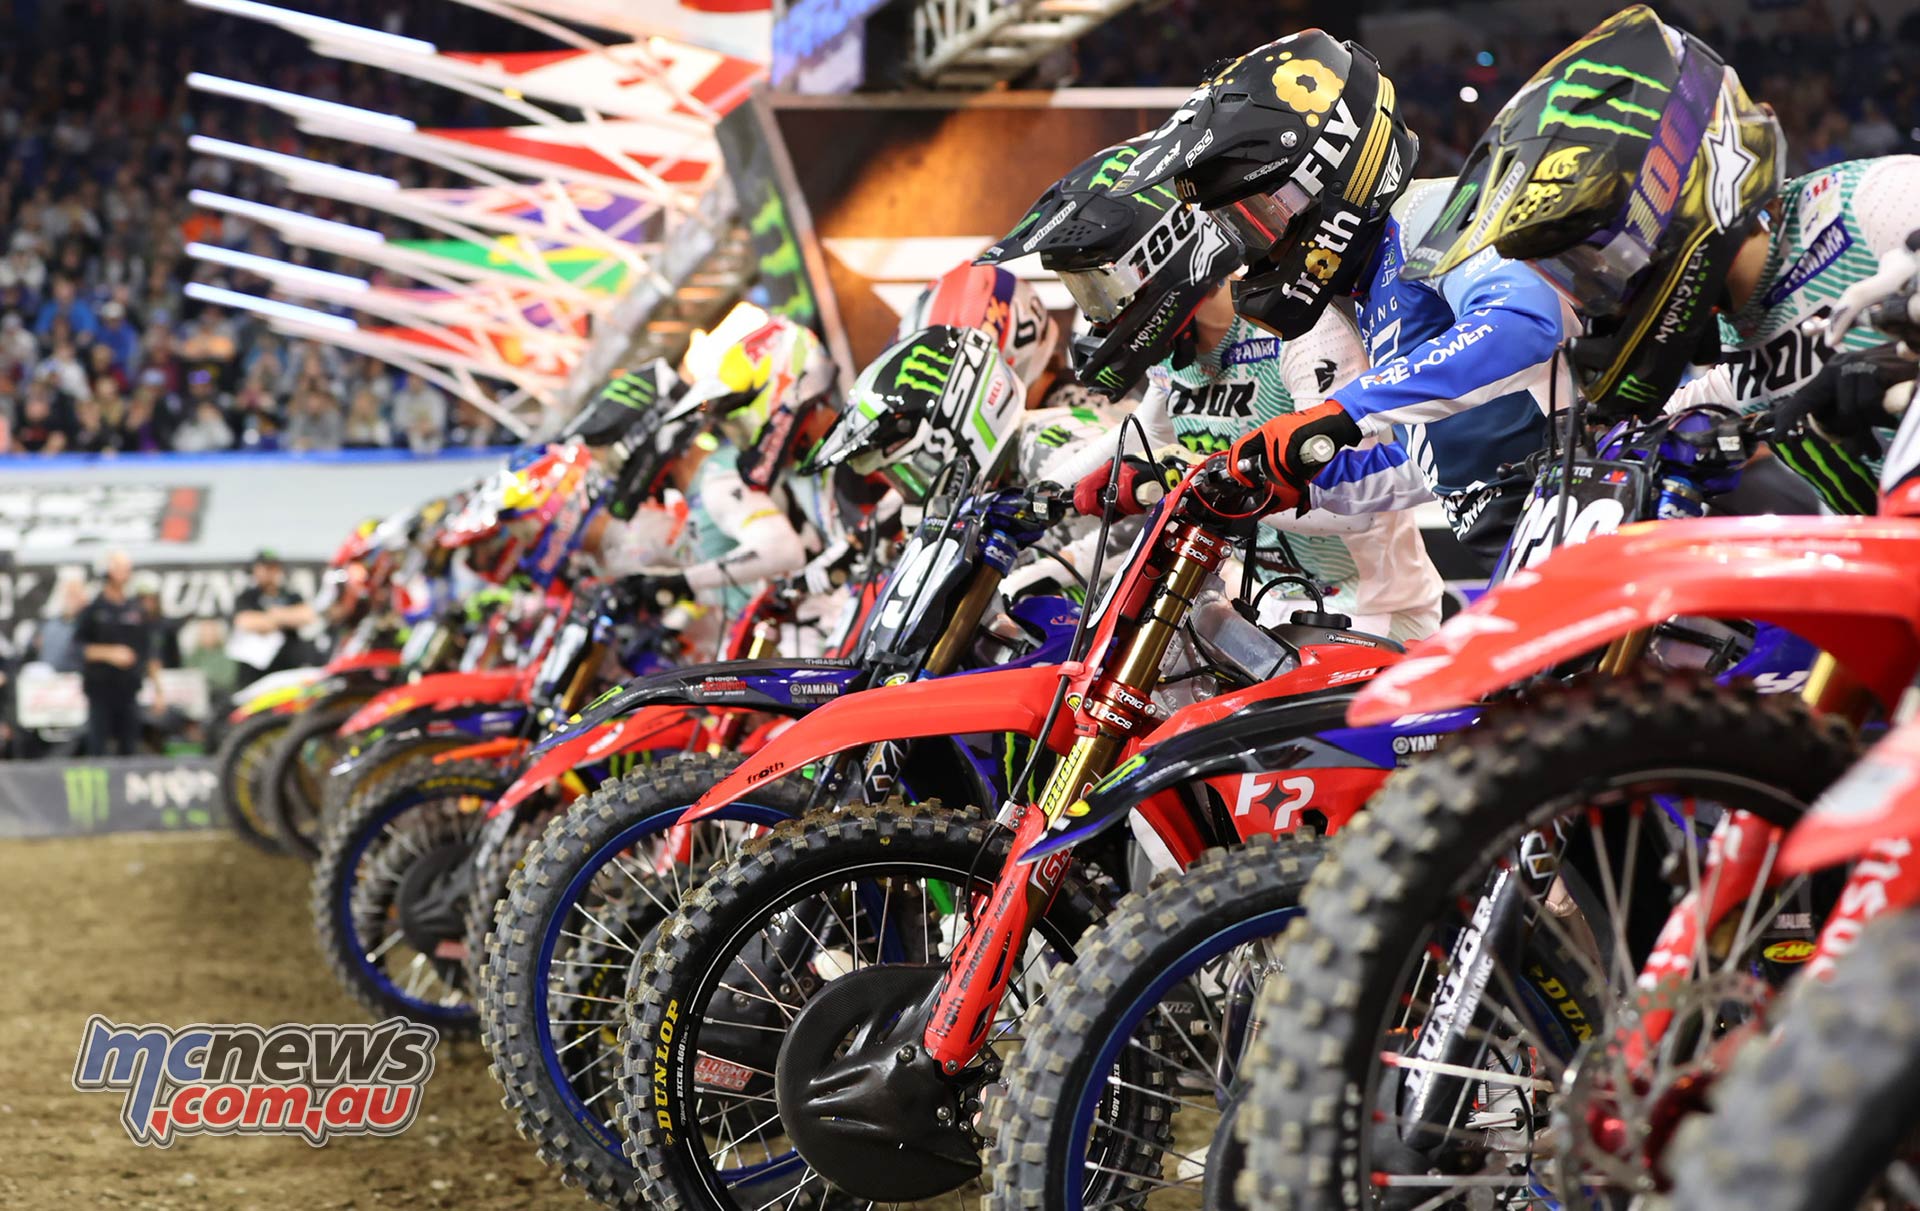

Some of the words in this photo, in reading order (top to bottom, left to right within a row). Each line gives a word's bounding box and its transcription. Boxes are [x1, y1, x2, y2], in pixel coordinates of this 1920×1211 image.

[1185, 128, 1214, 168] pod
[1290, 97, 1361, 196] FLY
[1023, 201, 1077, 253] apdesigns
[1655, 242, 1709, 343] MONSTER
[1130, 290, 1181, 352] MONSTER
[1414, 324, 1494, 374] POWER
[801, 684, 839, 695] YAMAHA
[1327, 668, 1377, 685] 250
[1408, 735, 1440, 752] YAM
[747, 760, 785, 785] froth
[959, 926, 994, 992] BRAKING
[936, 996, 965, 1038] froth
[1541, 977, 1594, 1041] DUN
[654, 999, 679, 1132] DUNLOP
[679, 1043, 687, 1065] A60
[696, 1058, 754, 1081] LIGHT
[676, 1064, 684, 1099] EXCEL
[694, 1071, 747, 1091] SPEED
